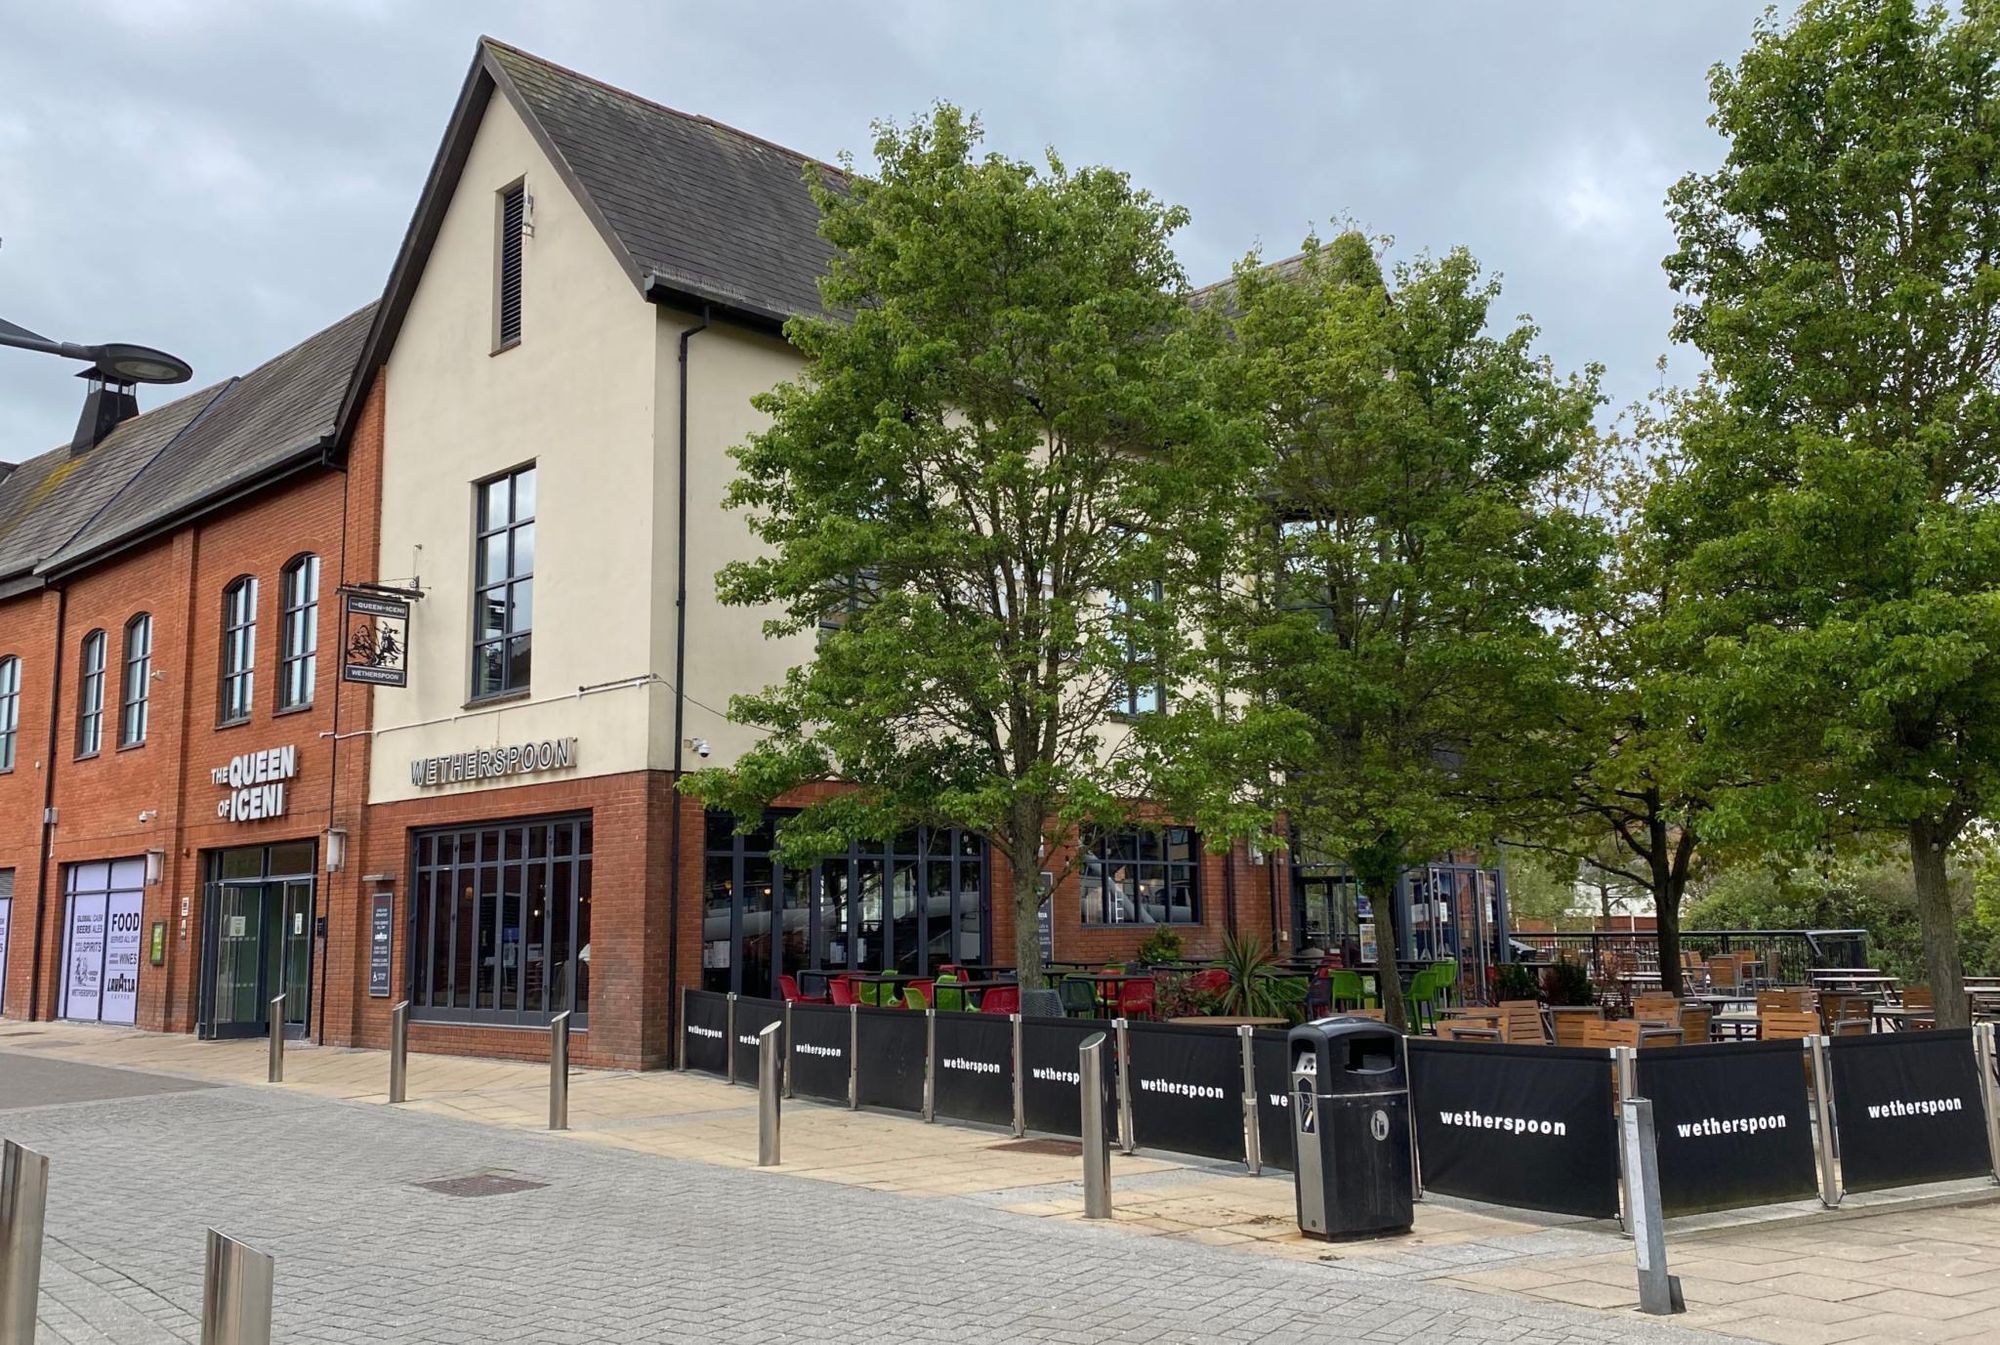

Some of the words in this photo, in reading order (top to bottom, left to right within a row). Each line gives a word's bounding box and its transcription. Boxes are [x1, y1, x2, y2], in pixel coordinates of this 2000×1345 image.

[358, 601, 382, 611] QUEEN
[351, 669, 399, 681] WETHERSPOON
[211, 766, 229, 785] THE
[229, 744, 295, 789] QUEEN
[411, 738, 573, 786] WETHERSPOON
[217, 799, 230, 817] OF
[230, 783, 284, 822] ICENI
[111, 912, 140, 932] FOOD
[120, 953, 137, 965] WINES
[688, 1025, 723, 1039] wetherspoon
[796, 1043, 841, 1057] wetherspoon
[943, 1057, 1000, 1074] wetherspoon
[1033, 1067, 1080, 1085] wethersp
[1141, 1077, 1225, 1099] wetherspoon
[1868, 1097, 1962, 1119] wetherspoon
[1440, 1108, 1567, 1137] wetherspoon
[1677, 1114, 1787, 1138] wetherspoon
